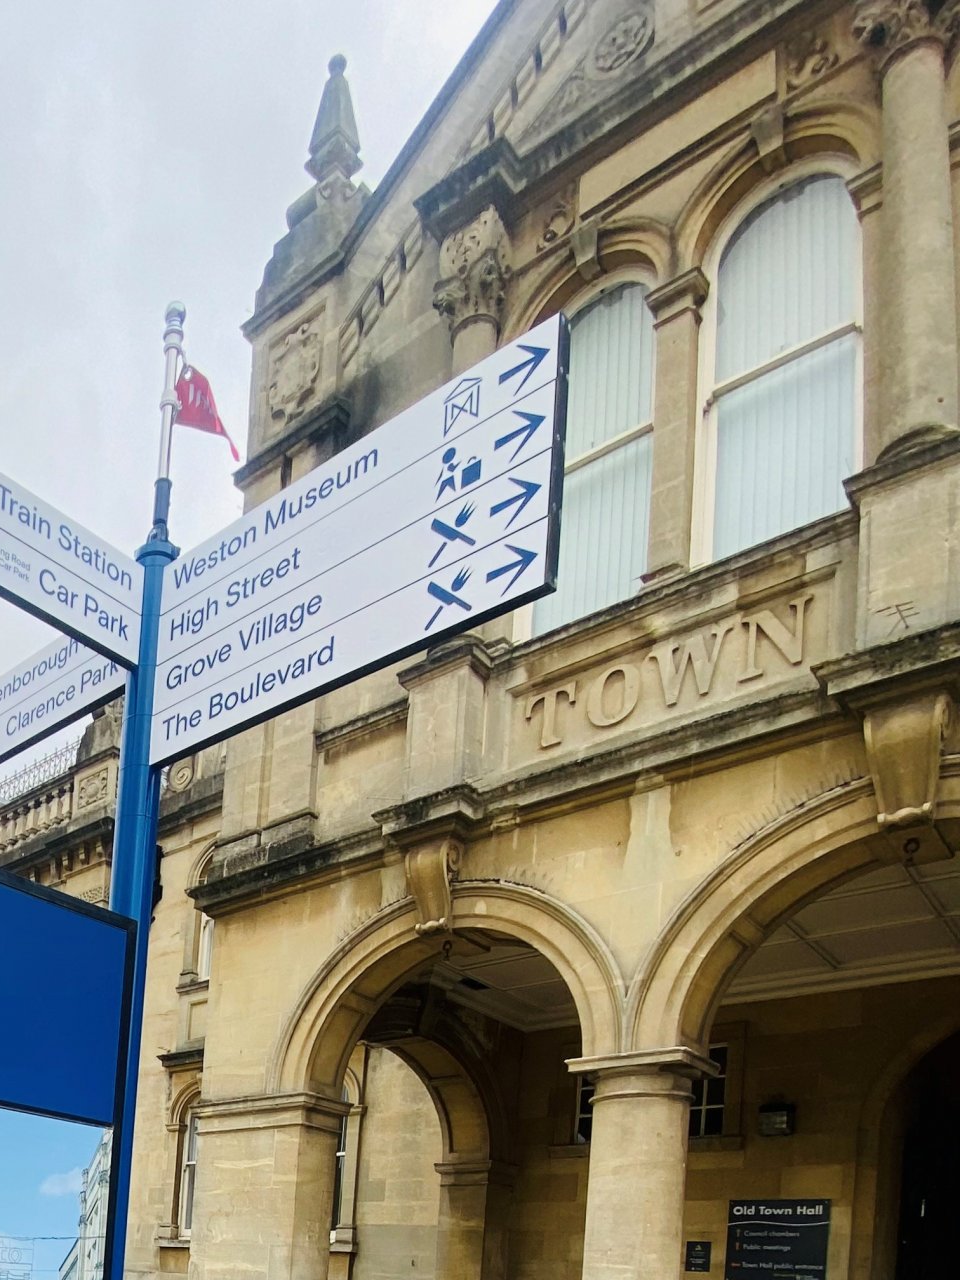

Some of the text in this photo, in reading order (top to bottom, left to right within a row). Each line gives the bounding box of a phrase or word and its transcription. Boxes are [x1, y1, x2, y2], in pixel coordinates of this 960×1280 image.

[173, 448, 378, 589] Weston Museum
[11, 553, 31, 571] Road
[13, 567, 30, 583] Park
[58, 524, 132, 591] Station
[170, 547, 301, 641] High Street
[39, 568, 129, 641] Car Park
[166, 594, 323, 690] Grove Village
[524, 594, 814, 751] TOWN
[6, 661, 119, 737] Clarence Park
[162, 635, 335, 741] The Boulevard
[733, 1205, 824, 1215] Old Town Hall
[763, 1244, 791, 1252] meetings
